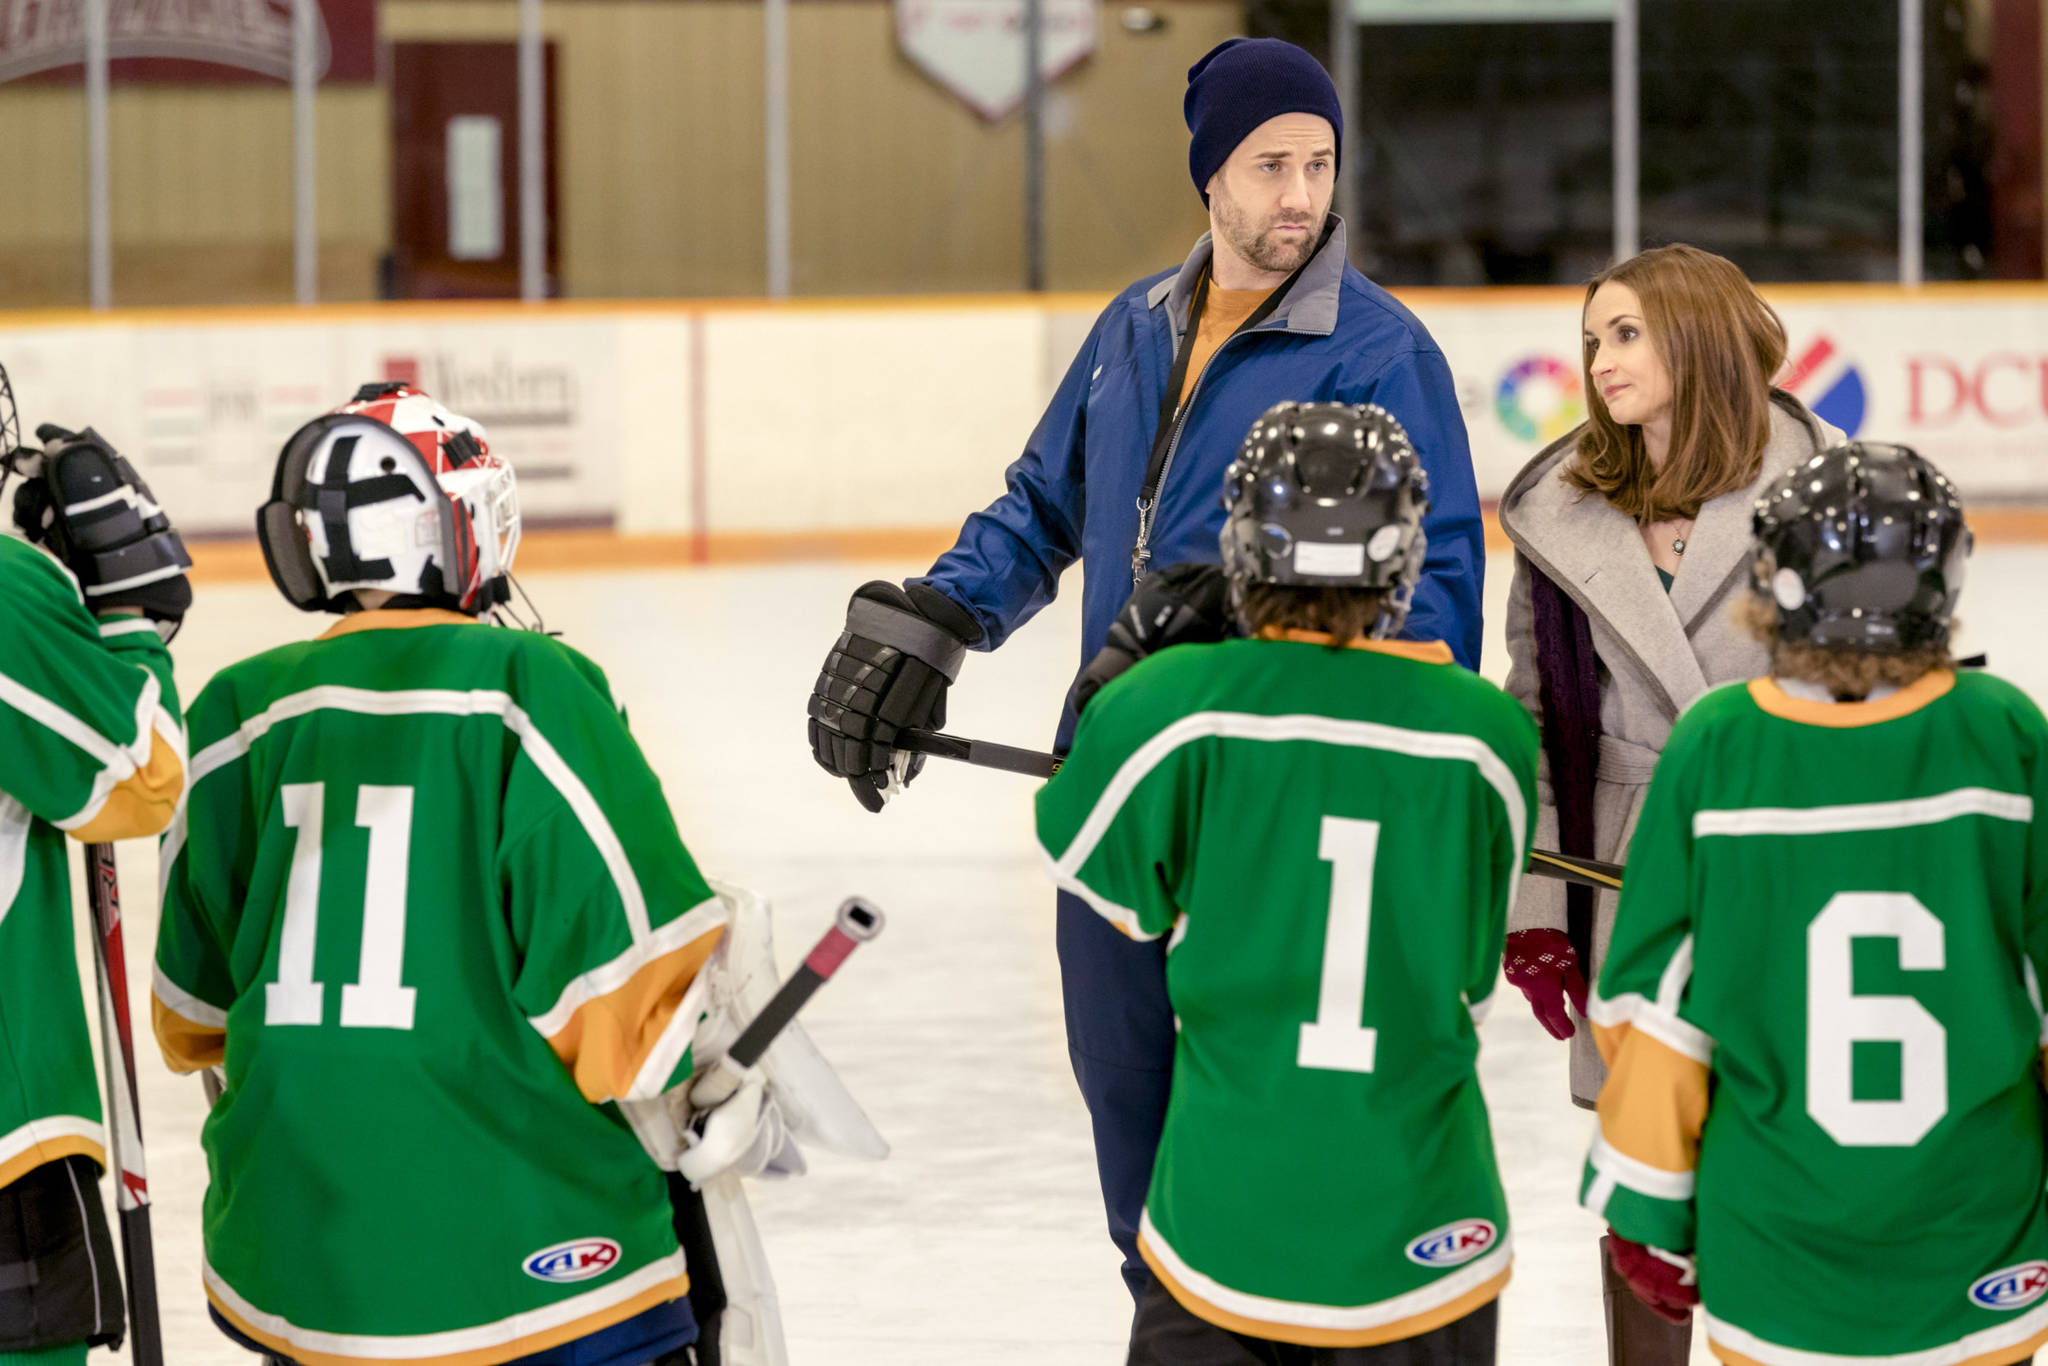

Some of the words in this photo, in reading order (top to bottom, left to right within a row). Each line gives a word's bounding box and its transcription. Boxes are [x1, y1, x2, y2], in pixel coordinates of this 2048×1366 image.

[265, 782, 417, 1030] 11
[1297, 815, 1380, 1073] 1
[1806, 891, 1948, 1146] 6
